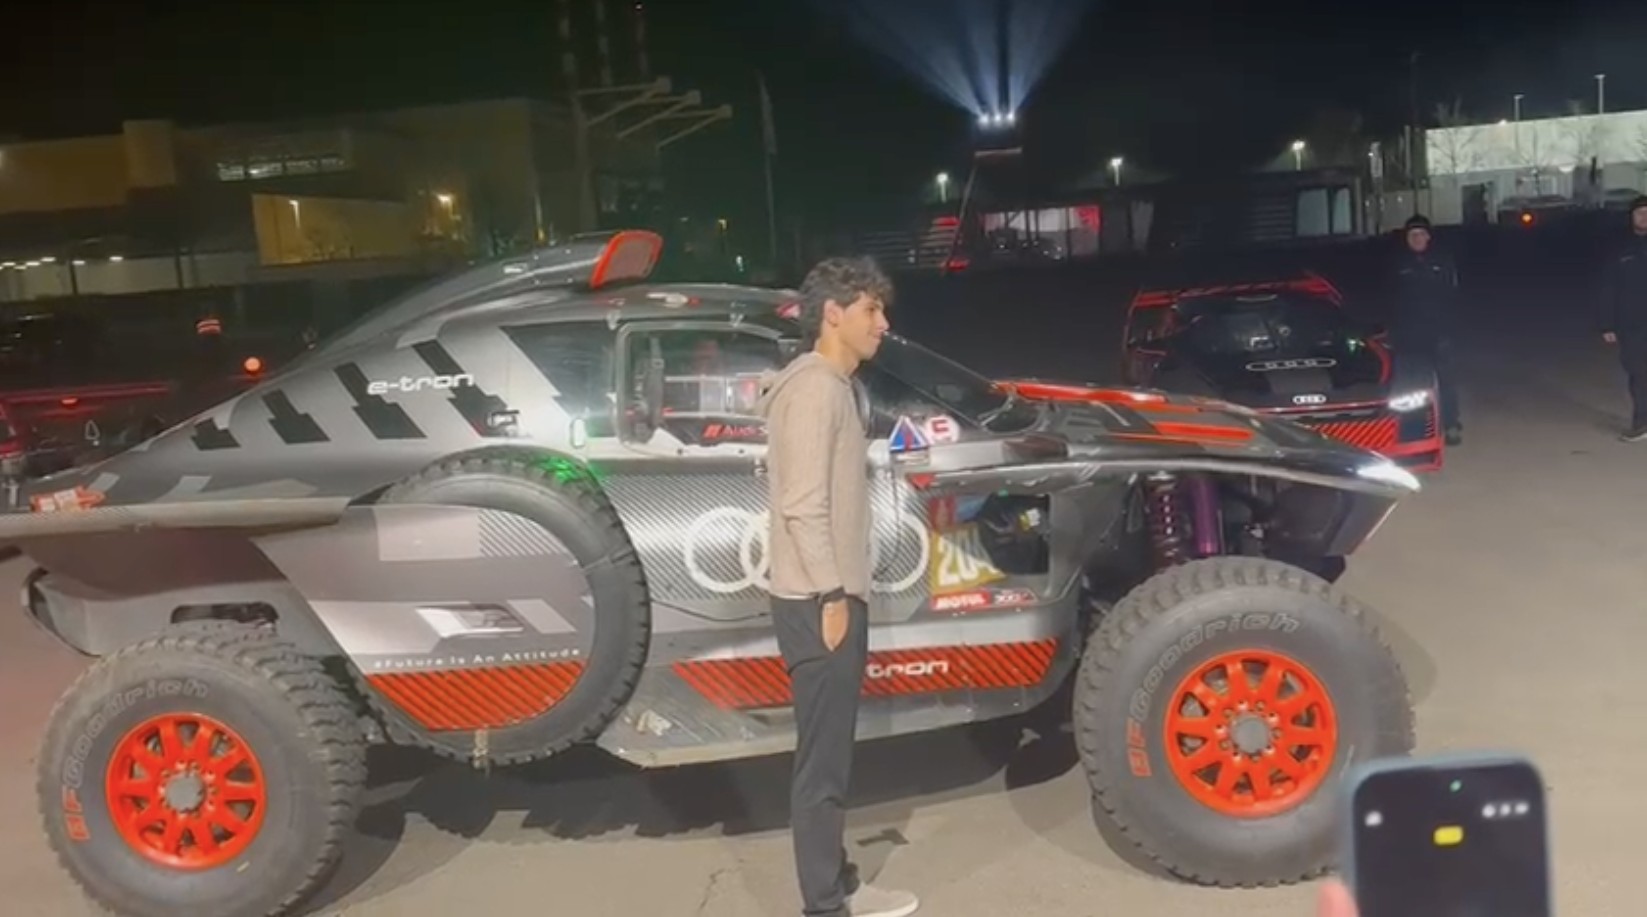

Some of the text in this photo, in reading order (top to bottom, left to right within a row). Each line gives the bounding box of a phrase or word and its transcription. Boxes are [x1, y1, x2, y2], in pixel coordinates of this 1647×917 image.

[366, 373, 474, 395] e-tron
[502, 648, 580, 662] Attitude
[866, 660, 949, 679] tron
[1127, 612, 1299, 777] BFGoodrich
